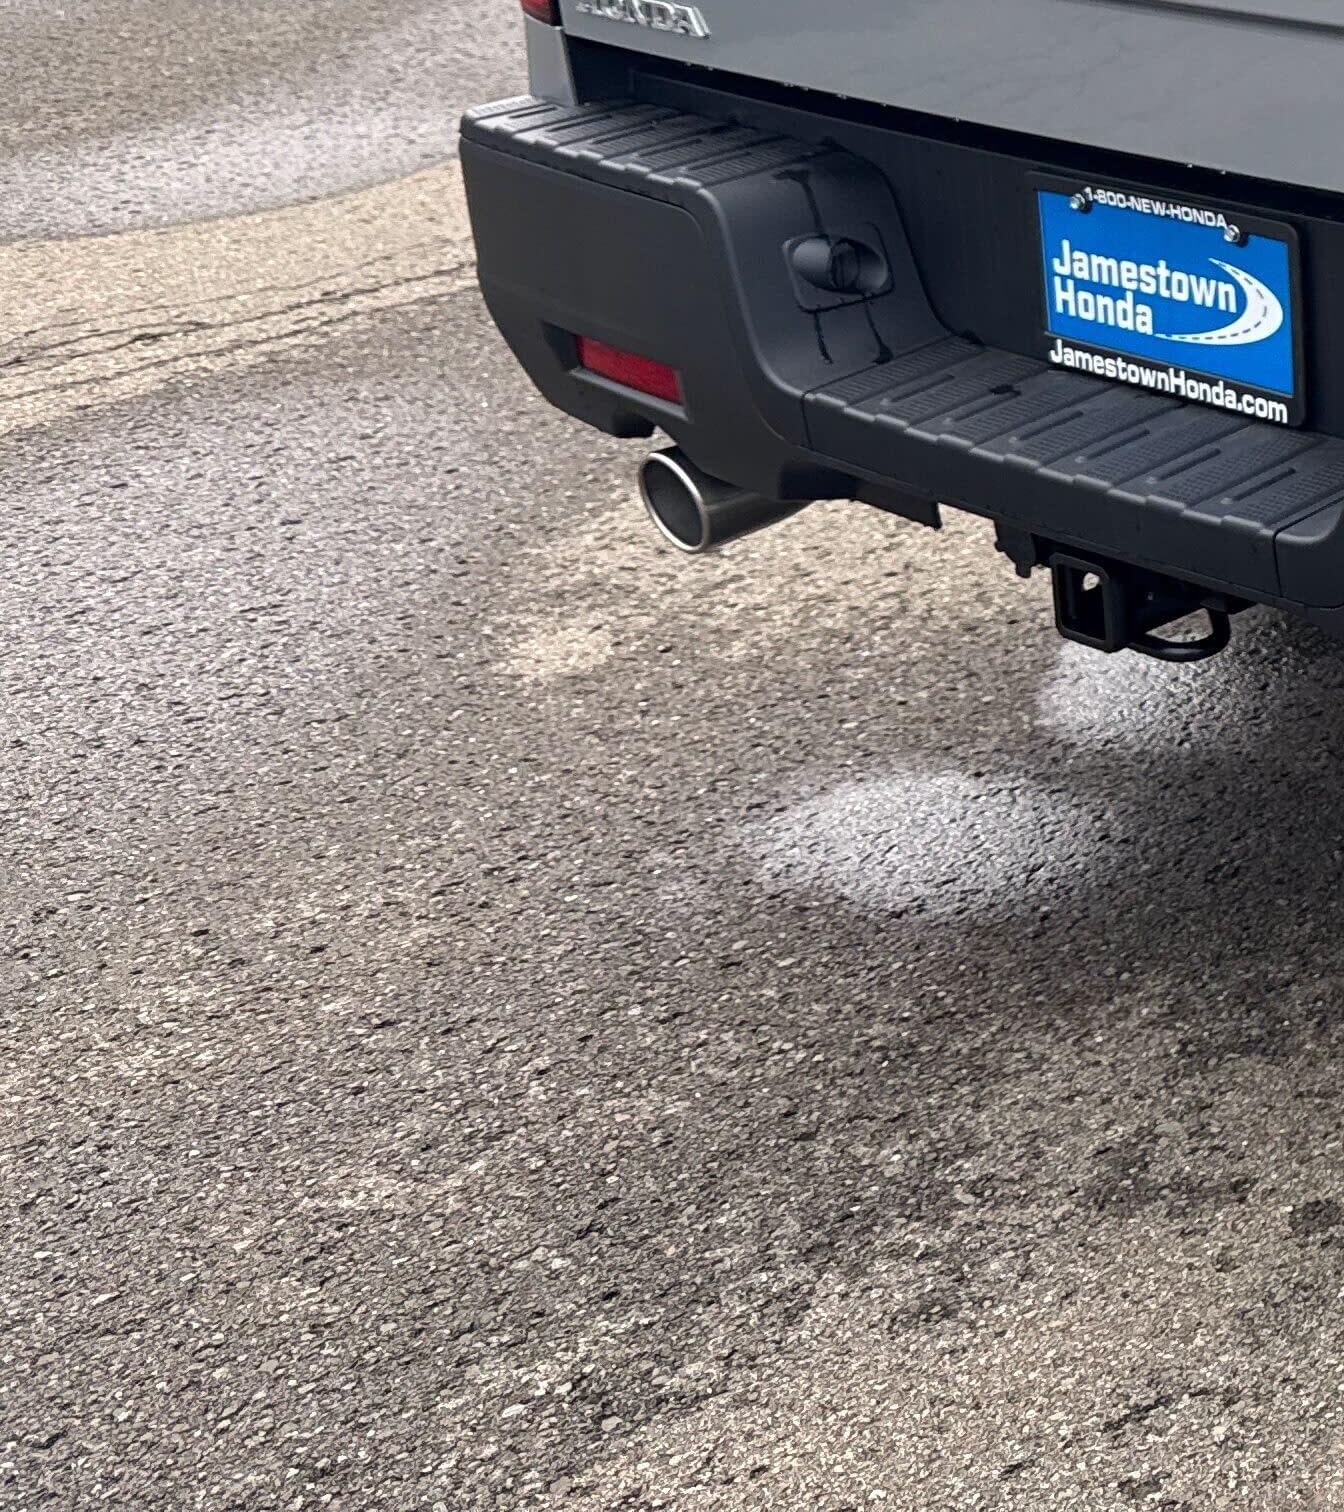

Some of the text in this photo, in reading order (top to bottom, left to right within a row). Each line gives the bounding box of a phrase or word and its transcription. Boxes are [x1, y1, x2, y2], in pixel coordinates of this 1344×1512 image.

[1084, 187, 1228, 229] 1-800-NEW-HONDA
[1052, 239, 1237, 314] Jamestown
[1053, 275, 1154, 336] Honda
[1049, 339, 1289, 424] JamestownHonda.com
